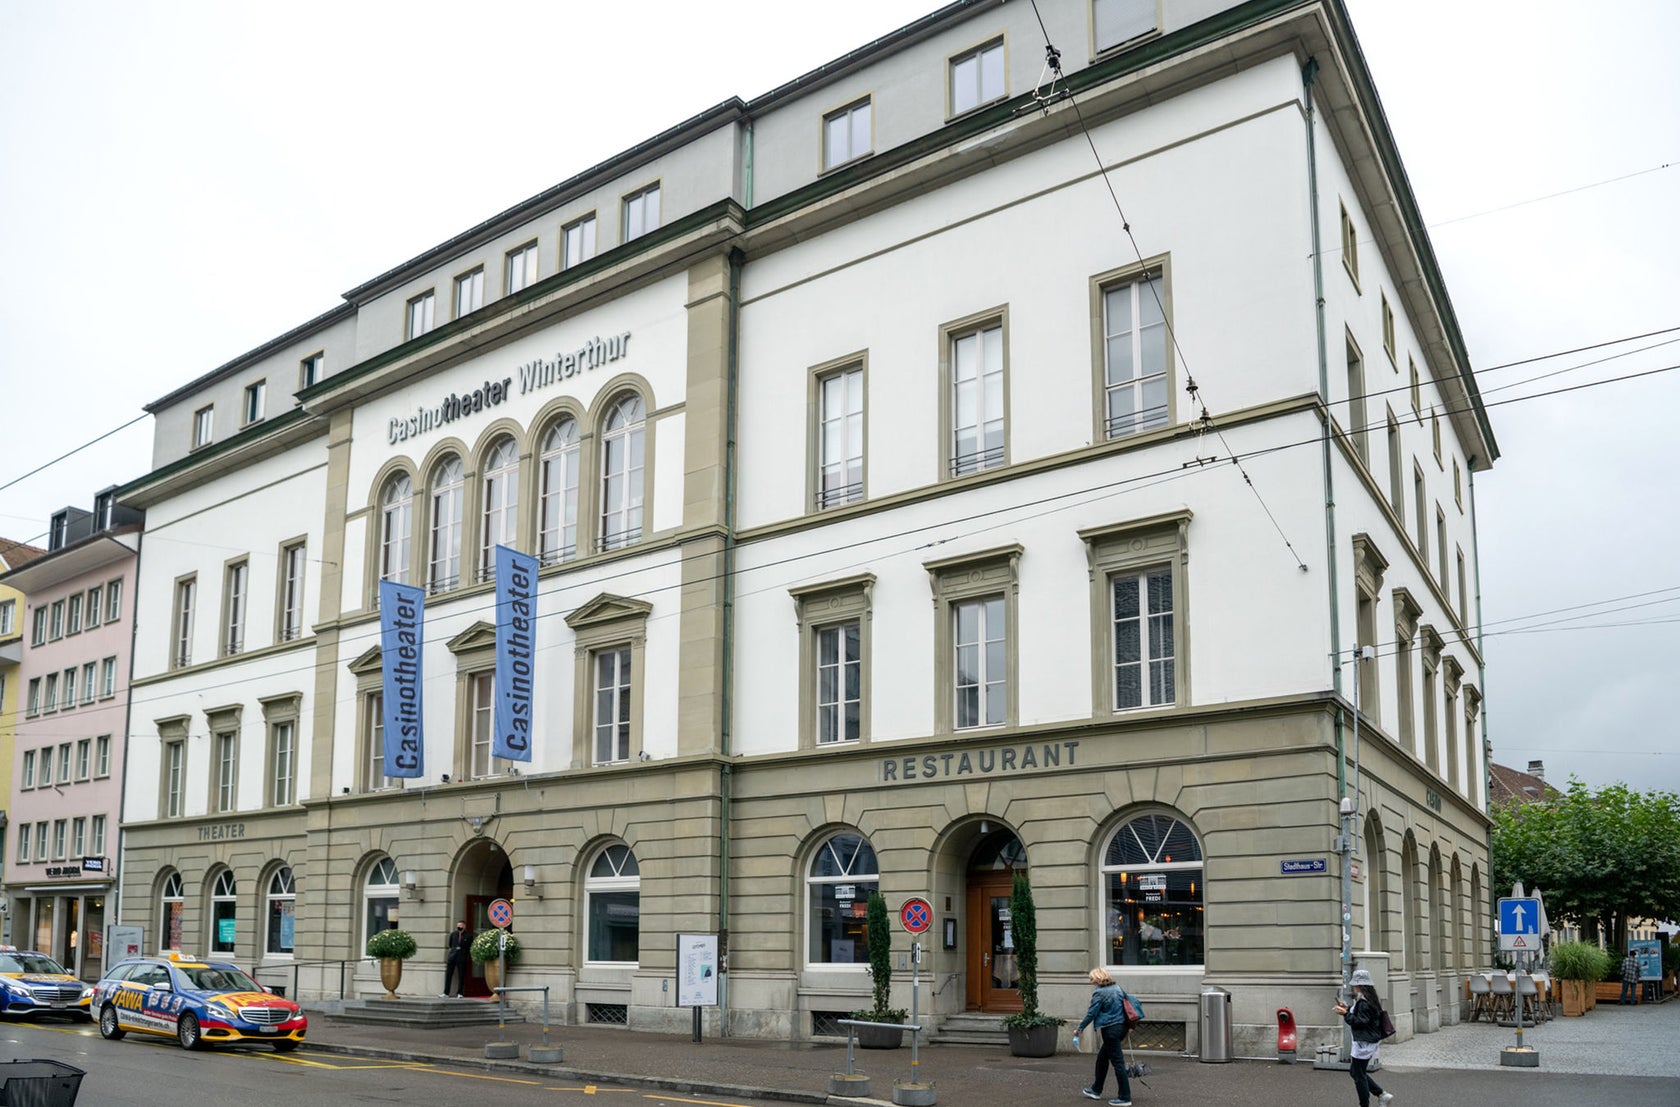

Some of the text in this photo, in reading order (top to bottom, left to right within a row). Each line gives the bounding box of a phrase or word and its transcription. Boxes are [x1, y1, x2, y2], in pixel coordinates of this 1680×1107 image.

[387, 331, 631, 445] Casinotheater Winterthur
[393, 592, 418, 770] Casinotheater
[506, 559, 531, 751] Casinotheater
[883, 741, 1080, 782] RESTAURANT
[197, 823, 245, 840] THEATER
